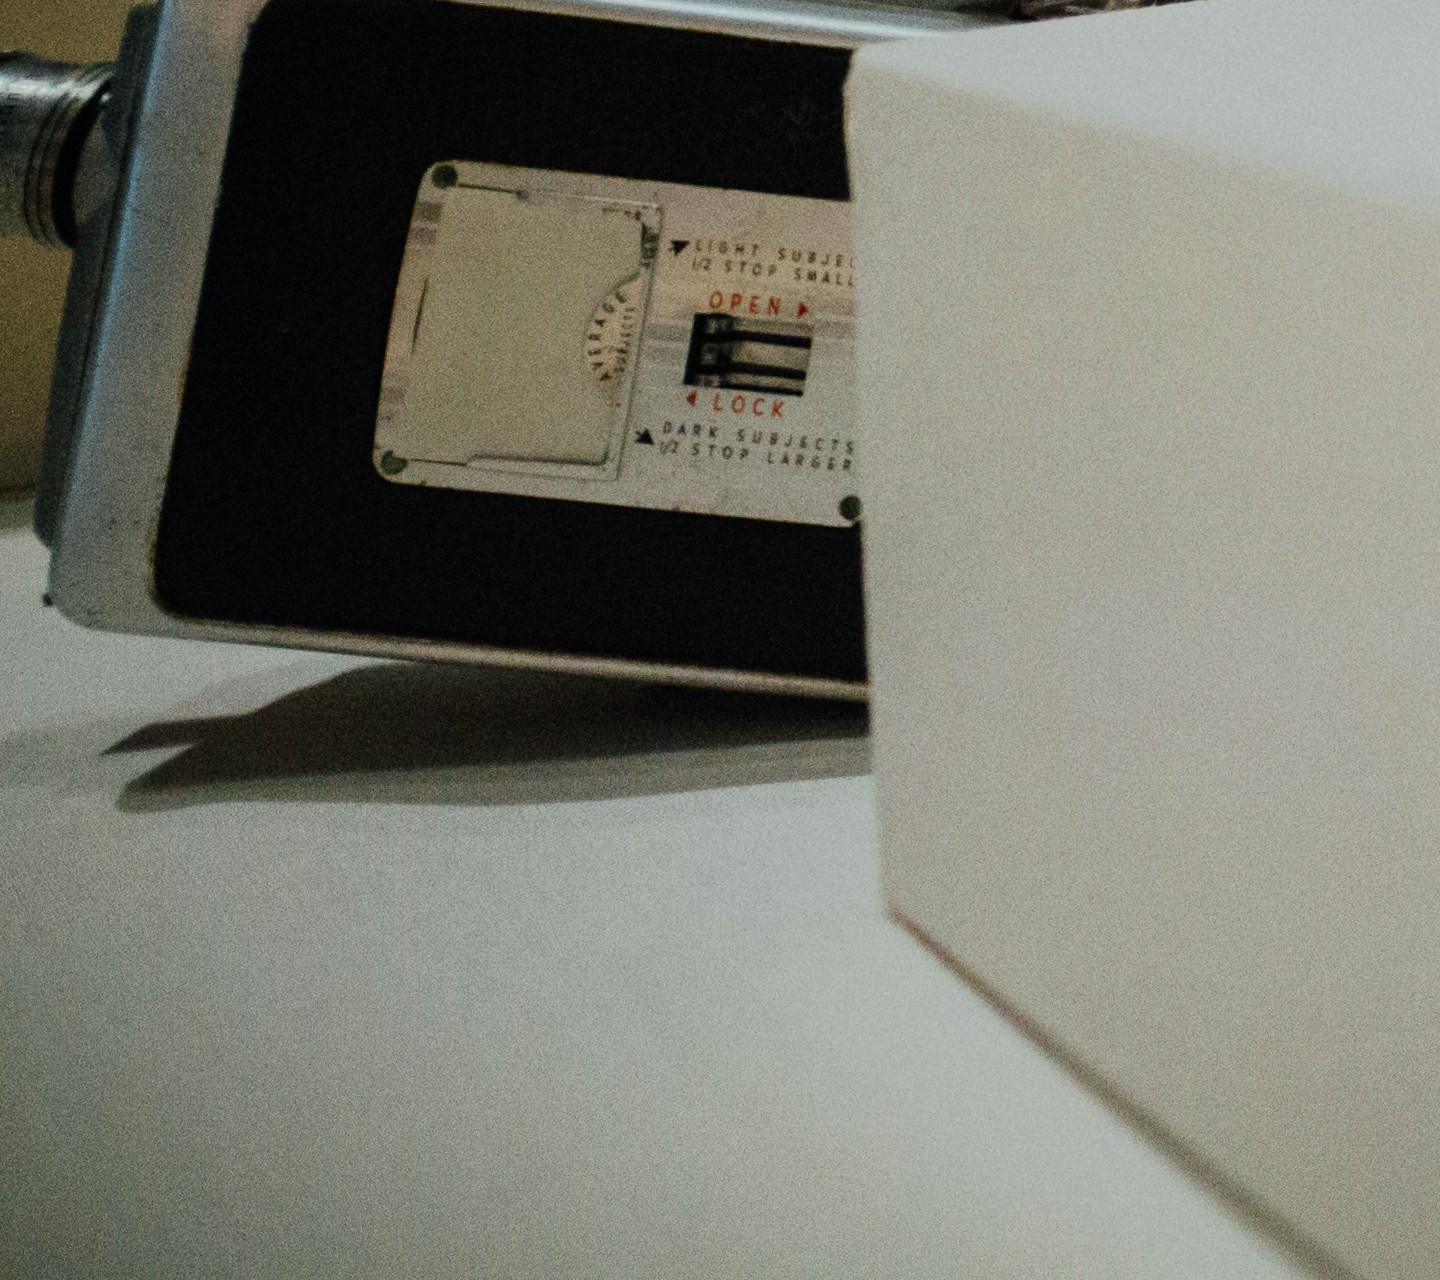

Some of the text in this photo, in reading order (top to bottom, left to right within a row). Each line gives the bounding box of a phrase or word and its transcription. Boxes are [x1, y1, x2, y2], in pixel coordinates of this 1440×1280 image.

[695, 239, 759, 255] LIGHT
[724, 259, 777, 277] STOP
[708, 290, 781, 315] OPEN
[712, 392, 785, 418] LOCK
[662, 421, 854, 455] DARK SUBJECTS
[691, 442, 749, 460] STOP
[767, 451, 852, 471] LARGER
